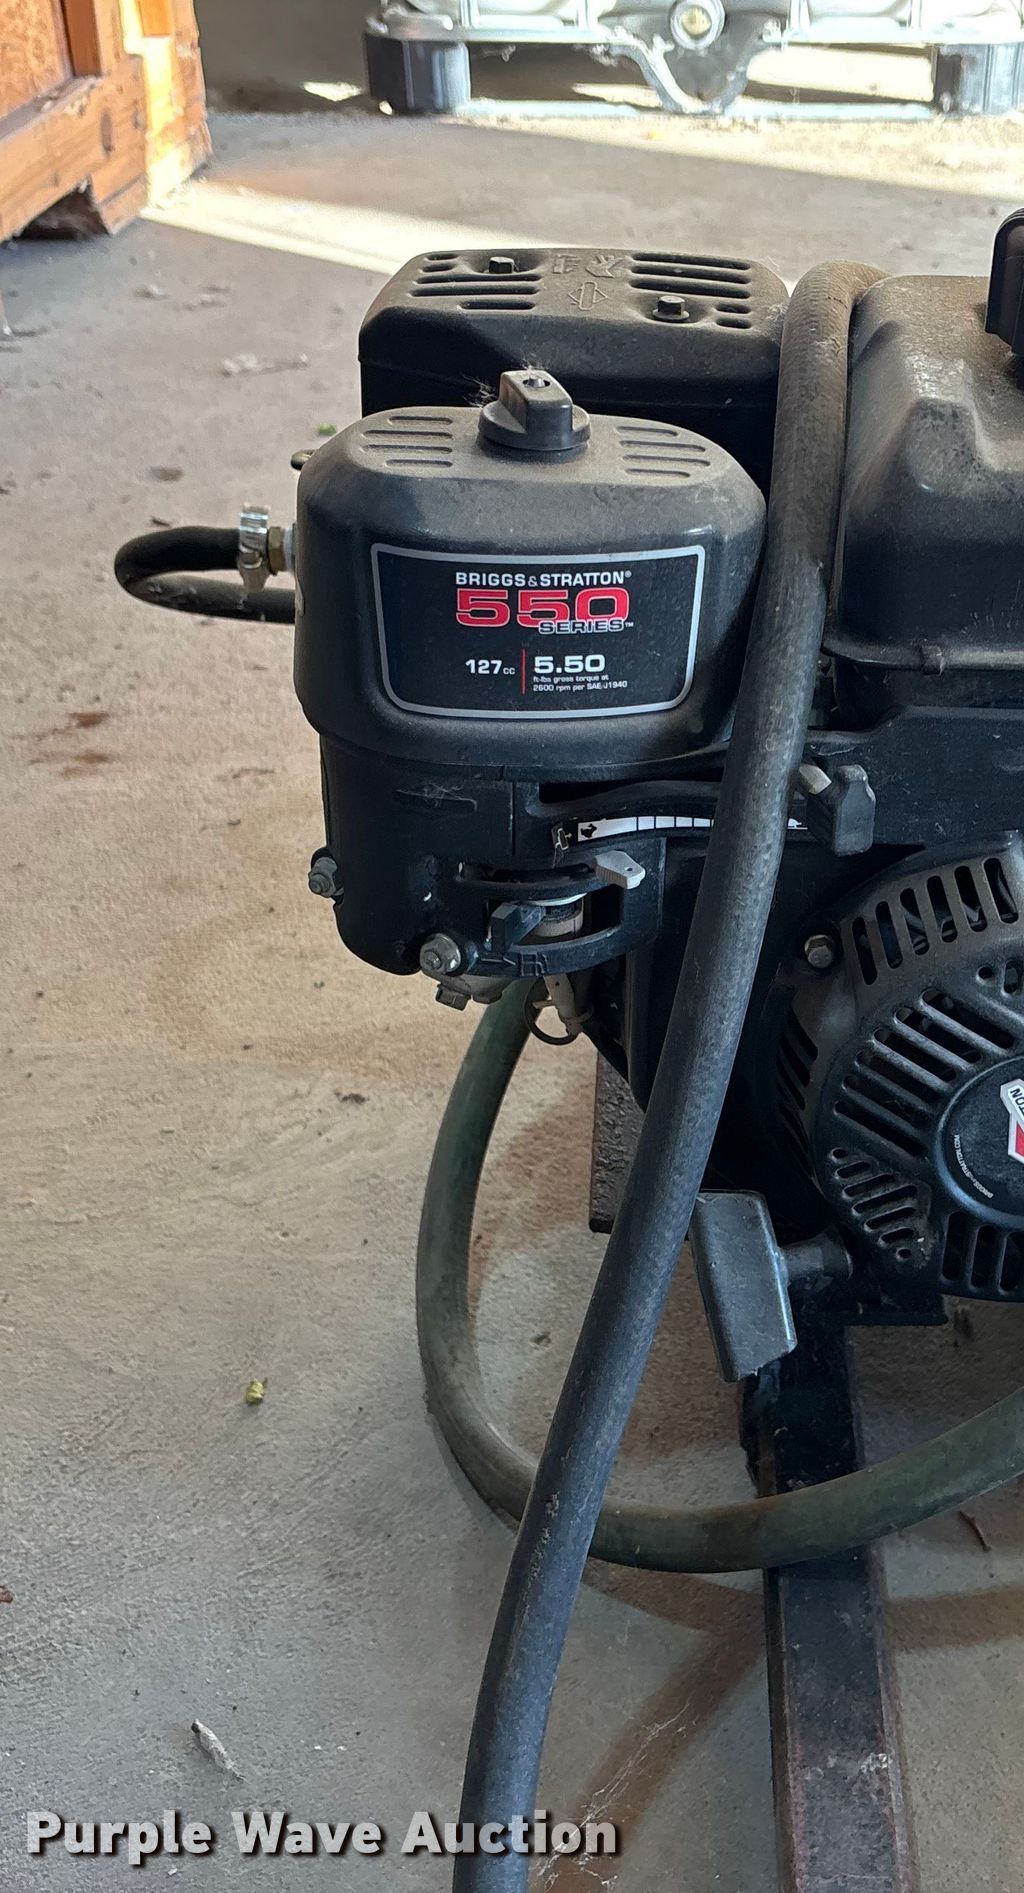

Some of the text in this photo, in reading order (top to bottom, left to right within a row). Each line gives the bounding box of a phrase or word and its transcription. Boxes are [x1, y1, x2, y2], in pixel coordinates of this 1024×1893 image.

[456, 587, 630, 627] 550
[534, 654, 606, 674] 5.50
[553, 676, 574, 684] gross
[575, 675, 599, 683] torque
[587, 682, 601, 690] SAE
[603, 680, 628, 689] J1940
